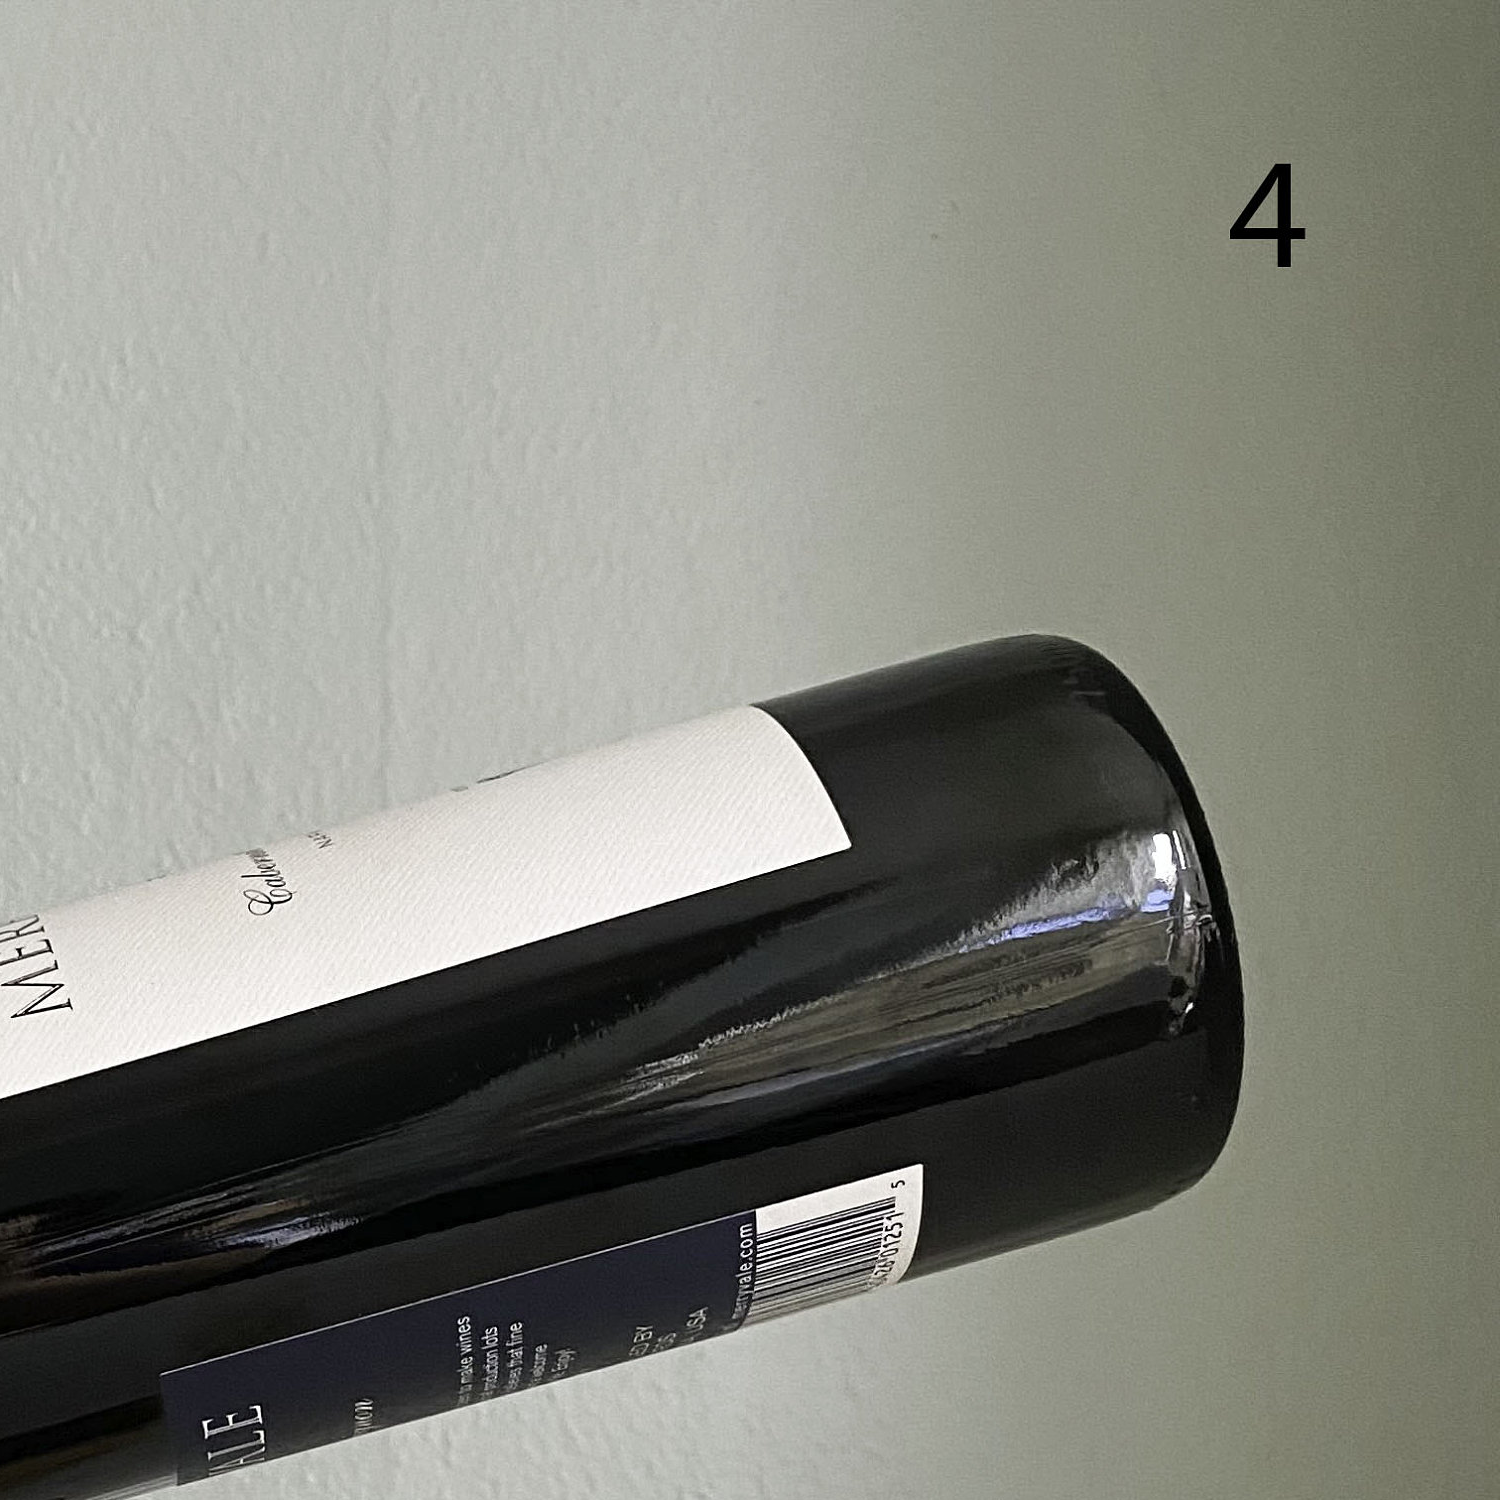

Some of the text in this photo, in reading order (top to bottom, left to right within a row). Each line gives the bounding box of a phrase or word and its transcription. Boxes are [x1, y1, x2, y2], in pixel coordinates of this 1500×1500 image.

[891, 1179, 906, 1190] 5
[455, 1315, 473, 1356] wines
[480, 1326, 499, 1350] lots
[506, 1321, 524, 1347] fine
[202, 1404, 266, 1477] ALE
